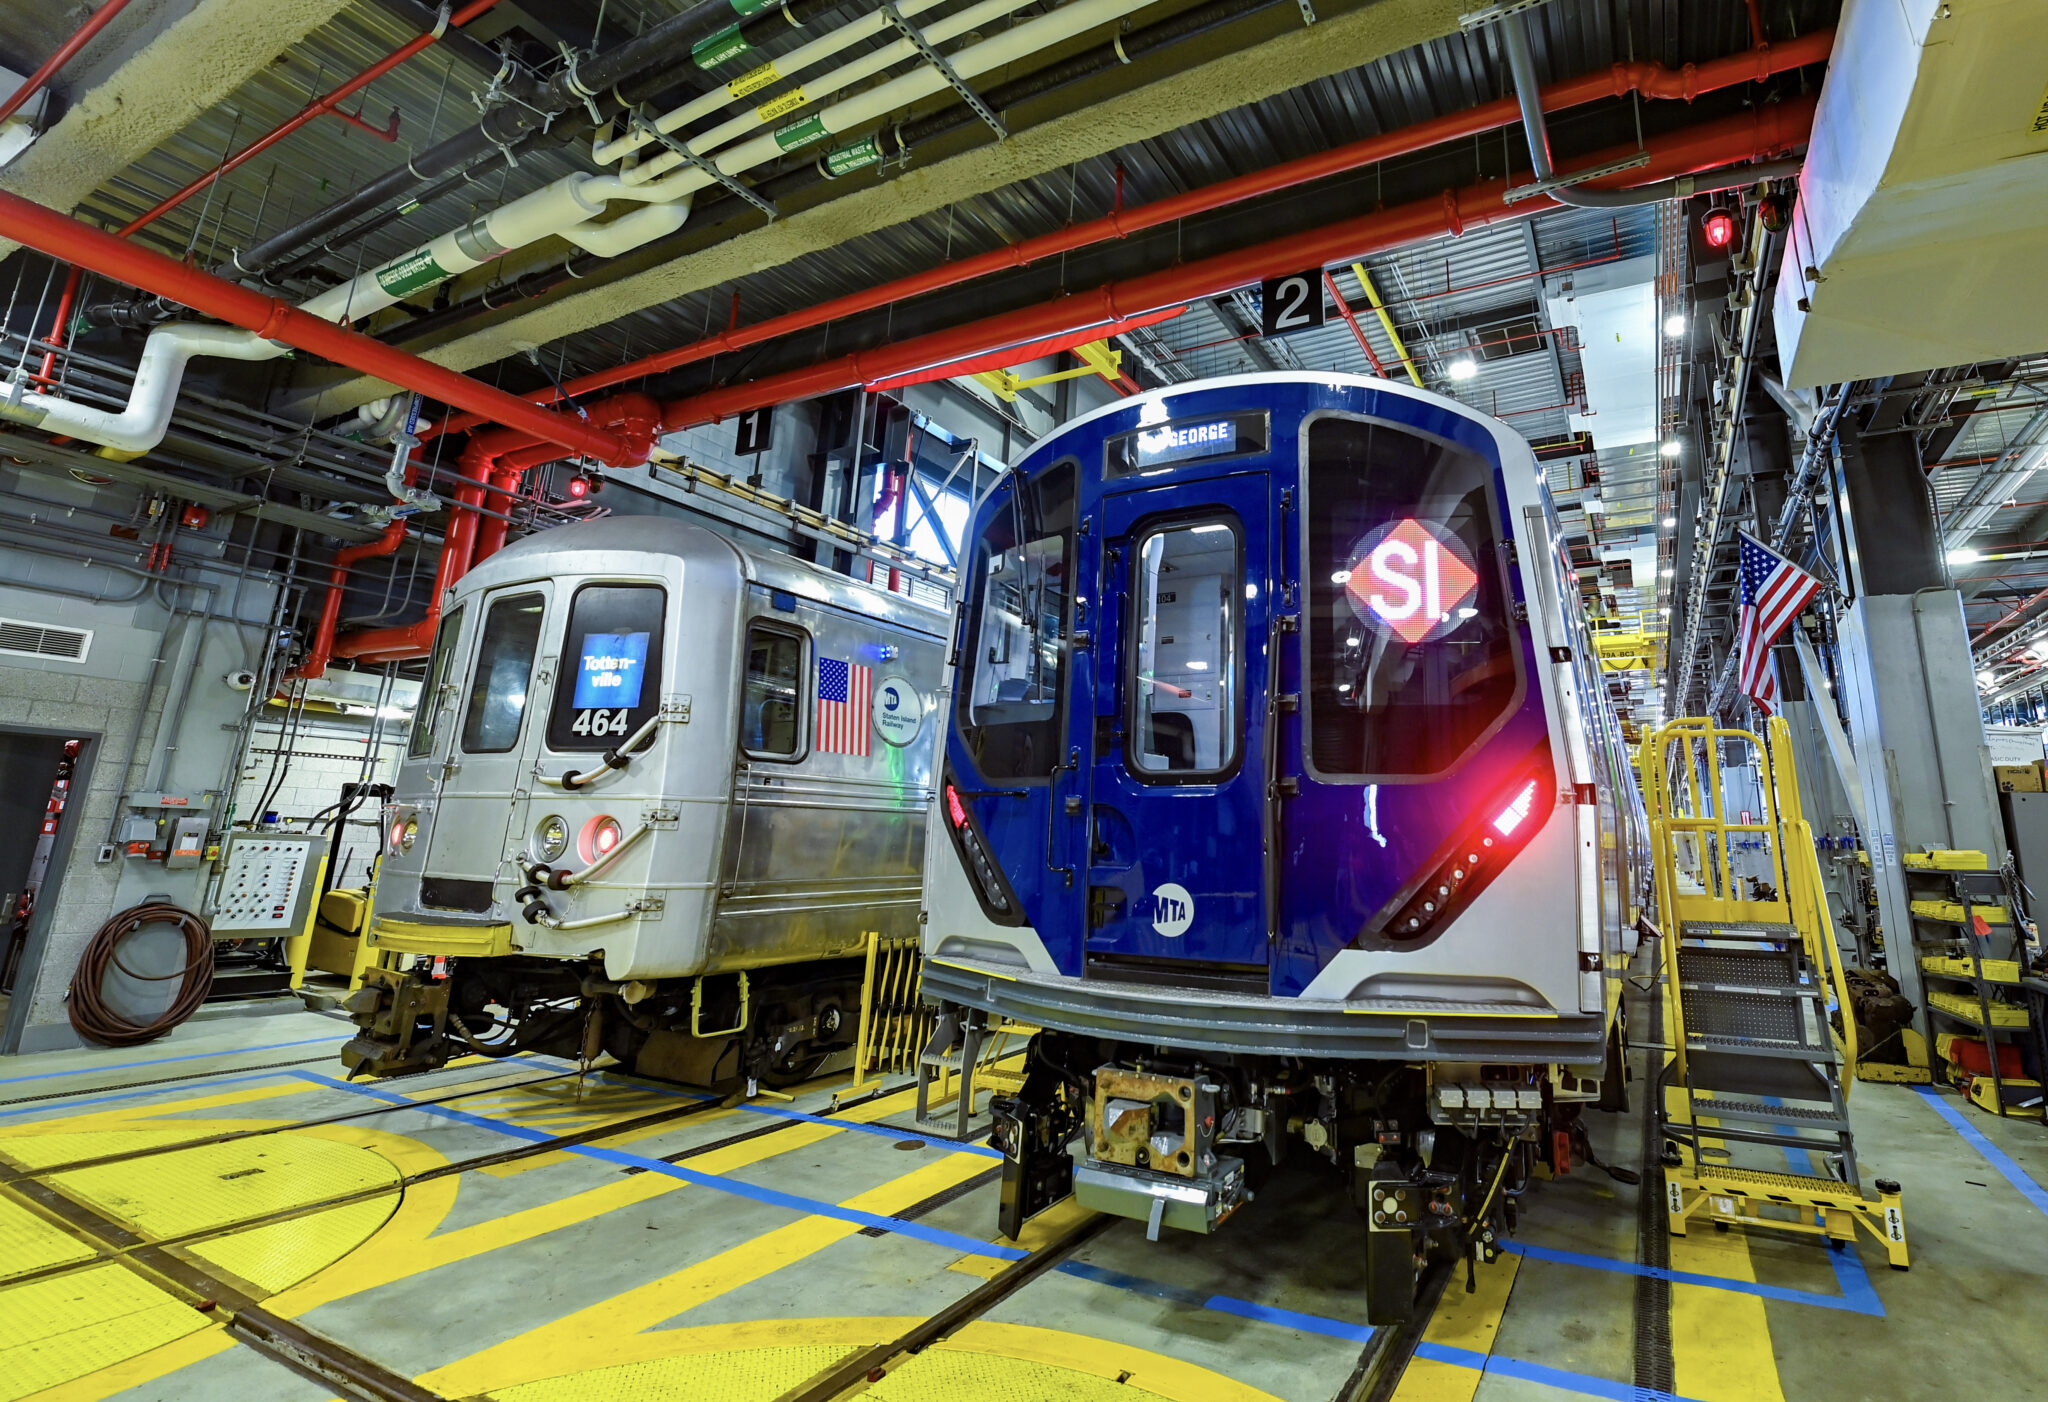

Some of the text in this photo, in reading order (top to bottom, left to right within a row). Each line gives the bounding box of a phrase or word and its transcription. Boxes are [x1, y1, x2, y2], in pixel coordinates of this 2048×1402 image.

[828, 144, 866, 163] INDUSTRIAL WASTE
[1276, 277, 1310, 329] 2
[746, 411, 759, 448] 1
[1171, 423, 1228, 447] GEORGE
[1370, 539, 1440, 619] SI
[584, 656, 636, 671] Totten-
[592, 672, 622, 687] ville
[572, 708, 628, 736] 464
[882, 712, 917, 724] Staten Island
[882, 720, 904, 730] Railway
[1153, 895, 1186, 924] MTA
